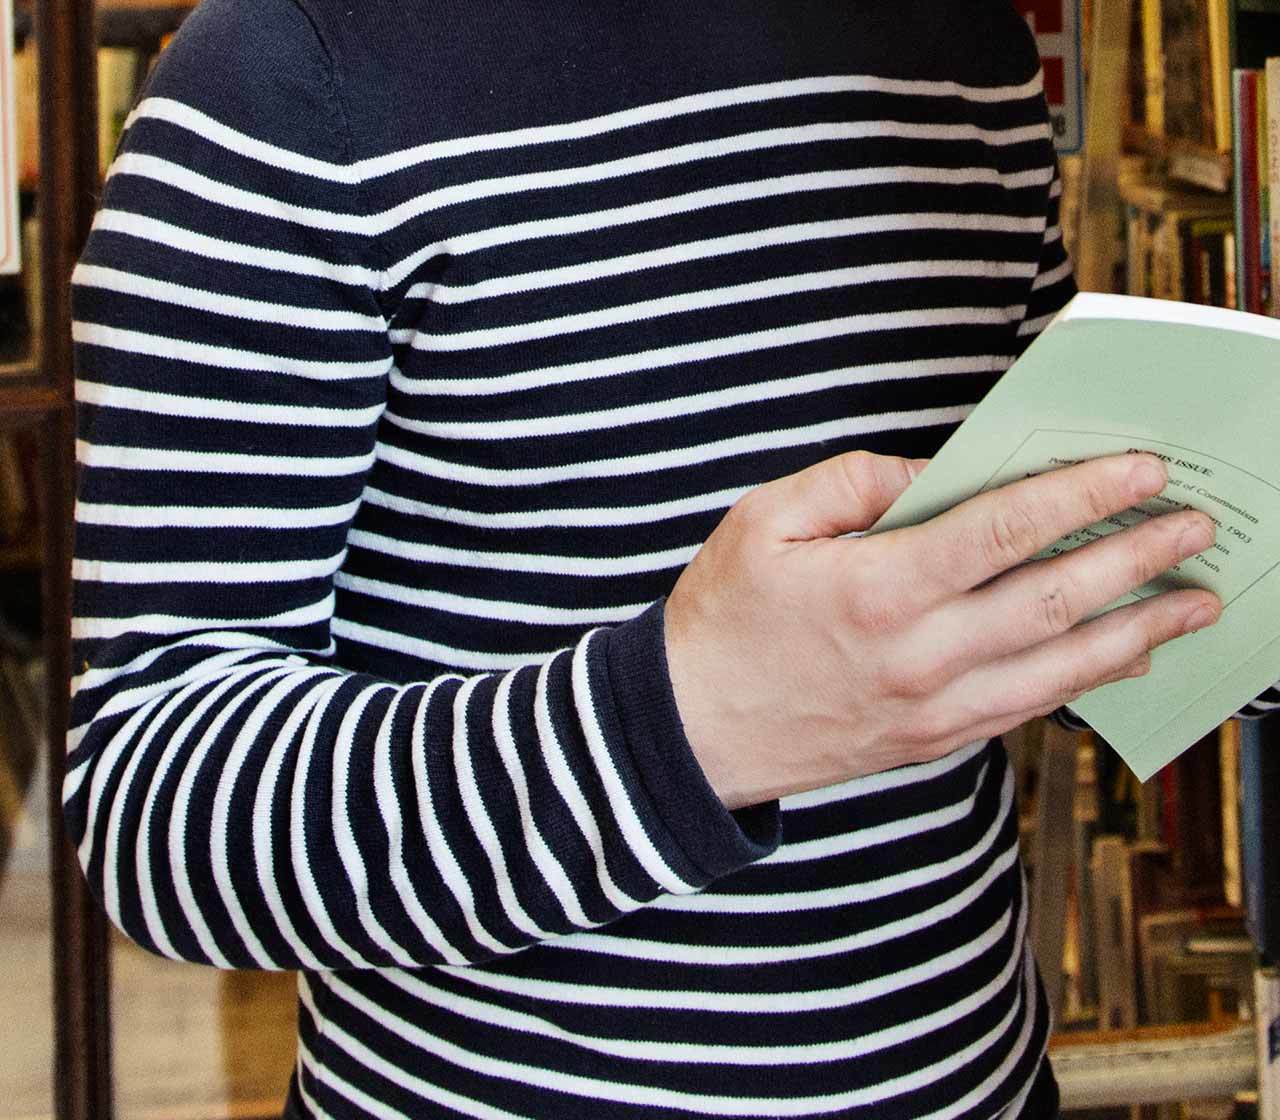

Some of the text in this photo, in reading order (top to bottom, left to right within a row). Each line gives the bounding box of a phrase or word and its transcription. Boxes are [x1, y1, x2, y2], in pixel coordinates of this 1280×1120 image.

[1173, 456, 1216, 479] ISSUE:
[1184, 482, 1196, 493] of
[1195, 487, 1261, 527] Communism
[1226, 524, 1253, 544] 1903
[1194, 553, 1222, 574] Truth
